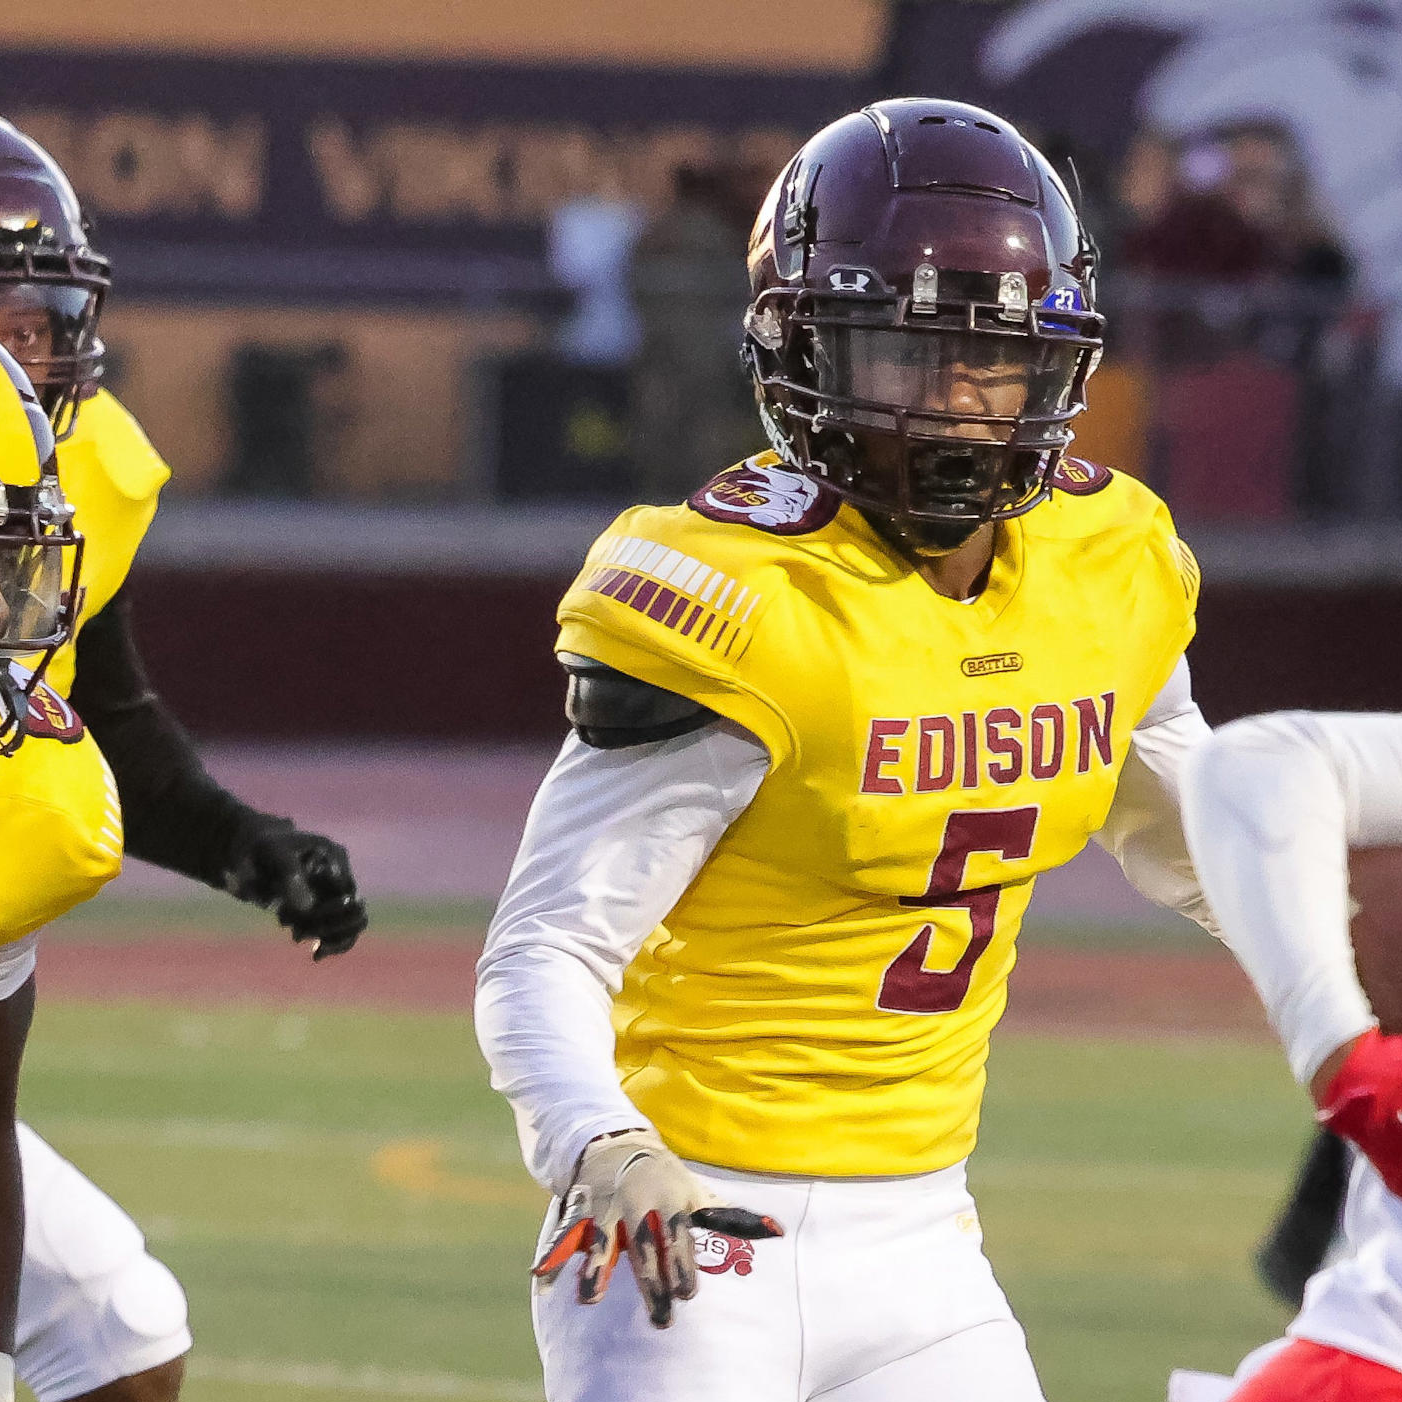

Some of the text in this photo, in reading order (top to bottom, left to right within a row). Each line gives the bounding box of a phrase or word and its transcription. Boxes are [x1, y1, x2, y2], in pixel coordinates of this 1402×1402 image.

[967, 656, 1019, 673] BATTLE
[860, 691, 1116, 796] EDISON
[874, 804, 1042, 1016] 5
